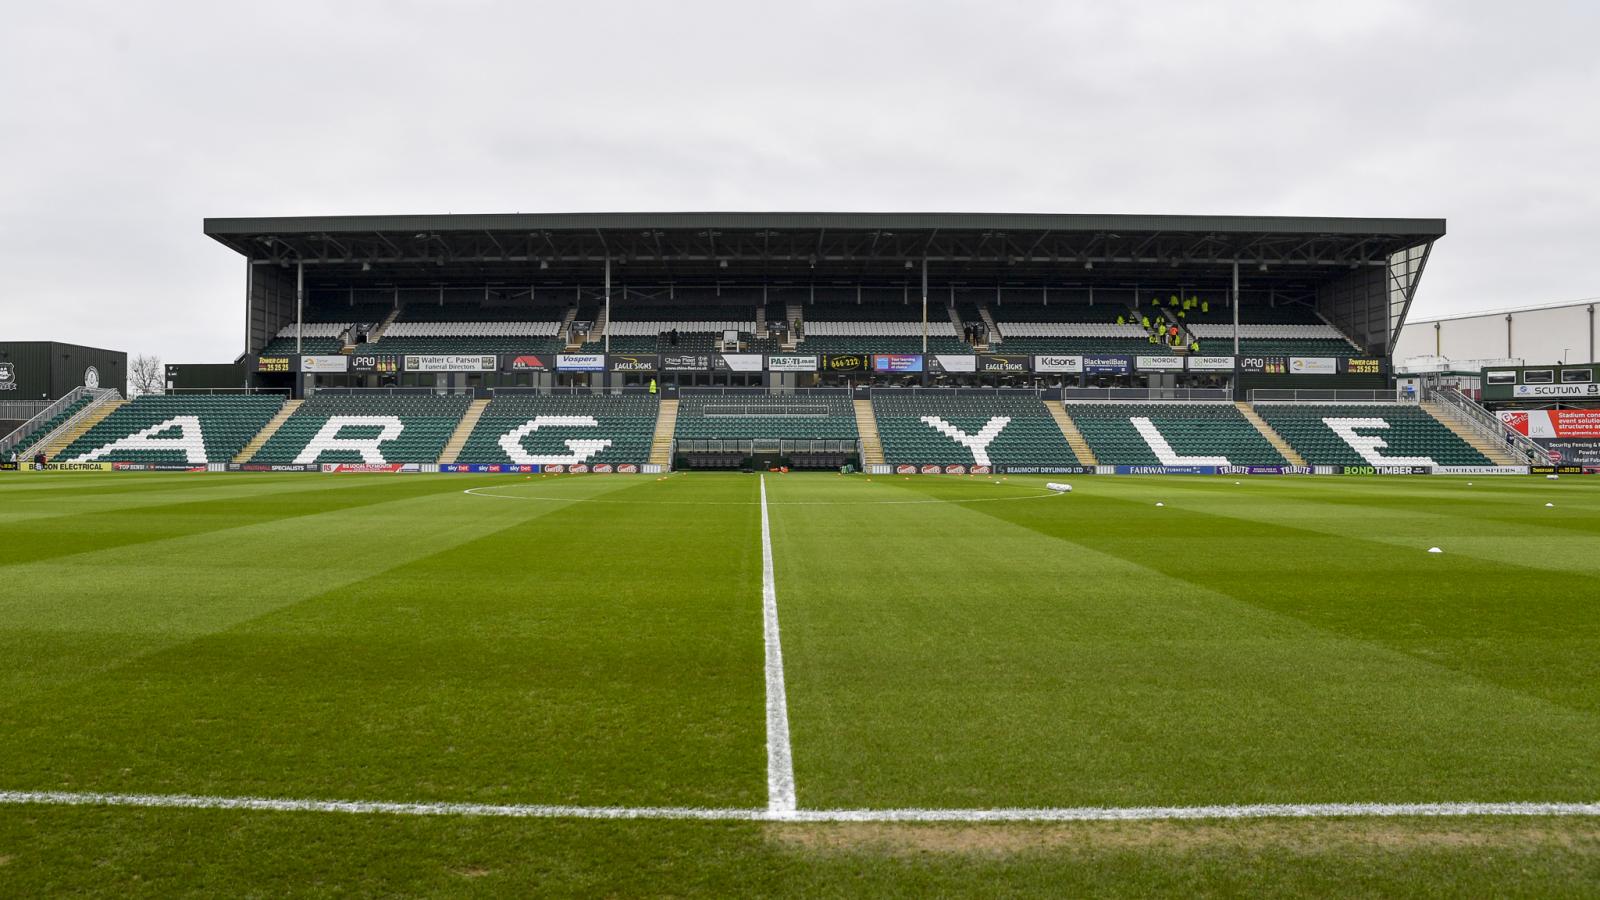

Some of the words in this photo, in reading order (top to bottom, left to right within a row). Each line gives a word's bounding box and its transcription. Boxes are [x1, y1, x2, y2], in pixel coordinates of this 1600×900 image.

[421, 357, 444, 365] Walter
[455, 357, 480, 365] Parson
[563, 356, 597, 364] Vospers
[1041, 357, 1076, 367] Kitsons
[1348, 358, 1366, 366] TOWER
[1534, 387, 1581, 395] SCUTUM
[1532, 425, 1544, 434] UK
[29, 463, 59, 471] BECON
[60, 463, 104, 471] ELECTRICAL
[1130, 466, 1168, 474] FAIRWAY
[1219, 466, 1250, 474] TRIBUTE
[1280, 466, 1311, 474] TRIBUTE
[1344, 466, 1374, 475] BOND
[1375, 466, 1412, 475] TIMBER
